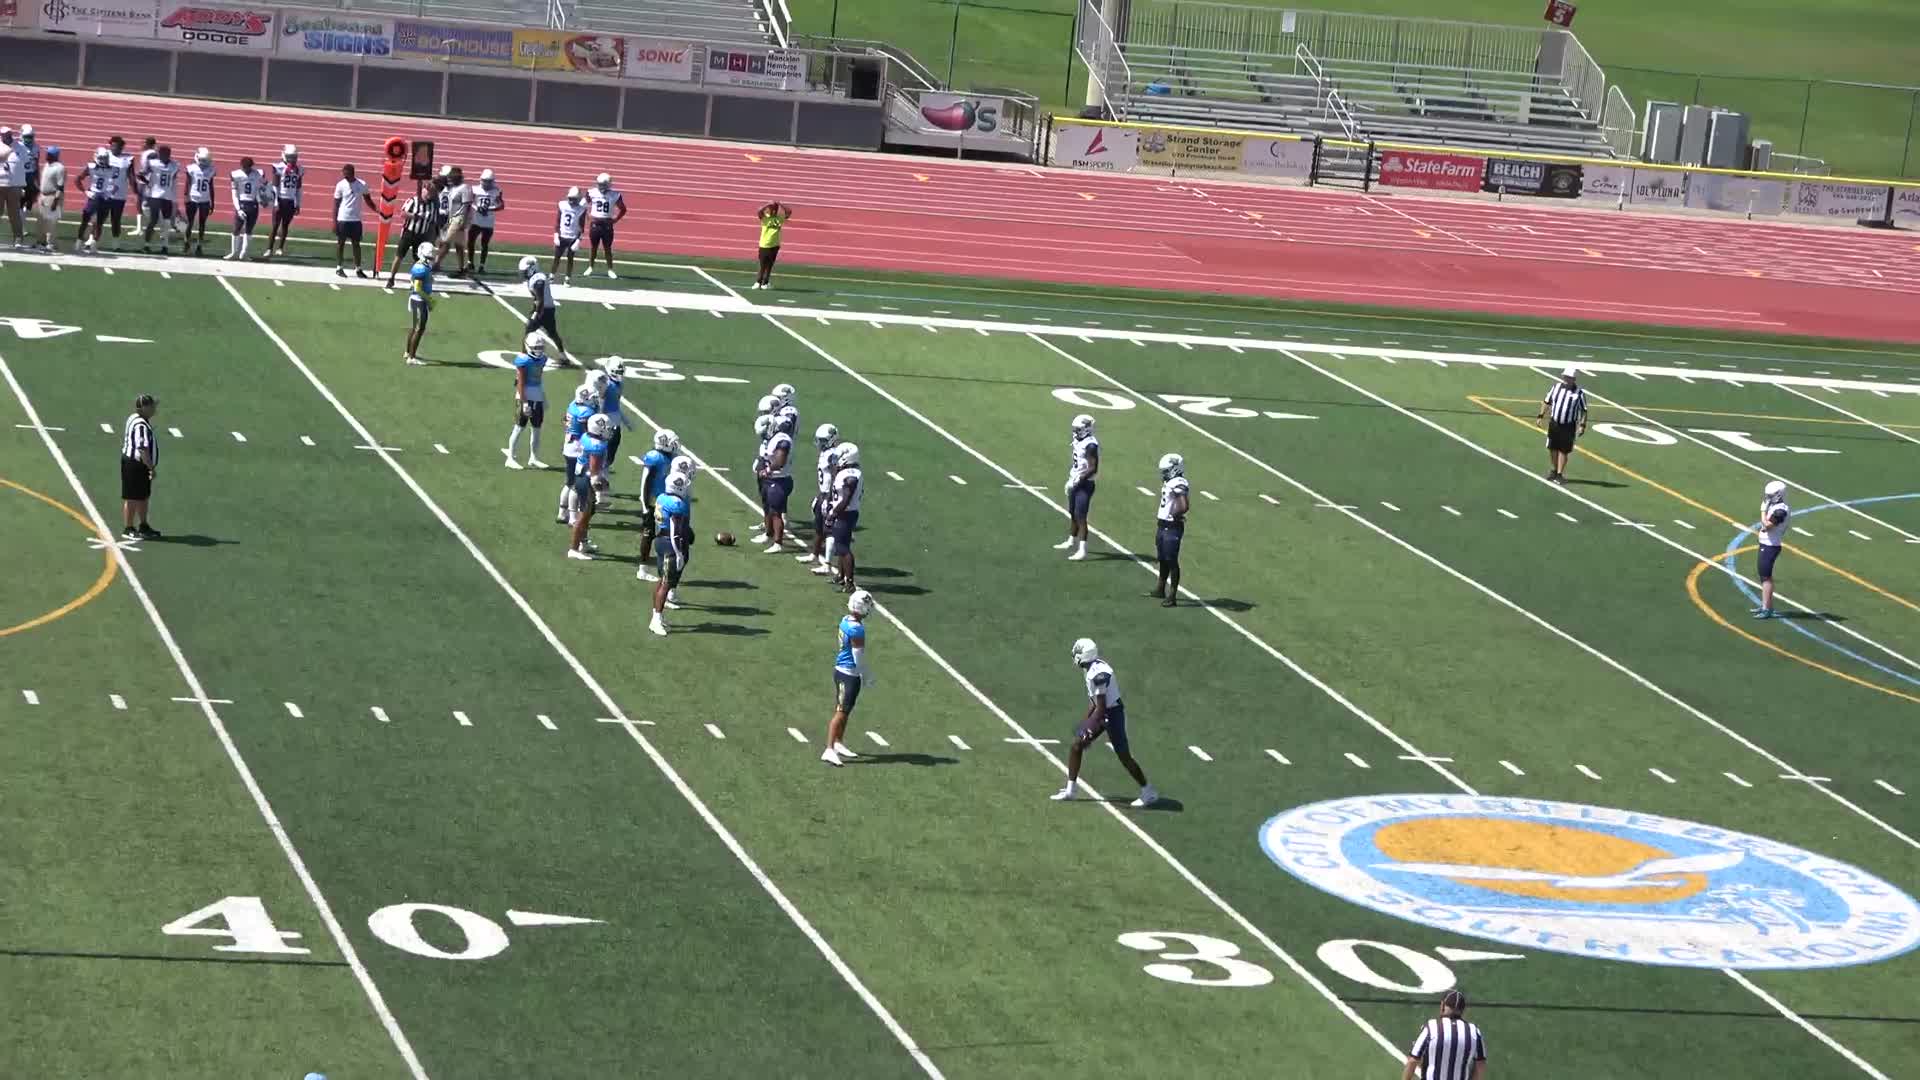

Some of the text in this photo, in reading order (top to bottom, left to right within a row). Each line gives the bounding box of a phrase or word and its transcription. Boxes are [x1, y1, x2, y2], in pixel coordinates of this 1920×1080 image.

[182, 31, 248, 45] DODGE
[304, 31, 390, 55] SIGNS
[636, 49, 683, 64] SONIC
[1167, 135, 1241, 149] Strand Storage
[1186, 145, 1220, 154] Center
[1493, 162, 1540, 178] BEACH
[596, 200, 610, 213] 28
[564, 213, 573, 227] 3
[1304, 803, 1367, 826] OF
[1280, 822, 1341, 870] CITY
[1364, 892, 1912, 966] SOUTH CAROLINA
